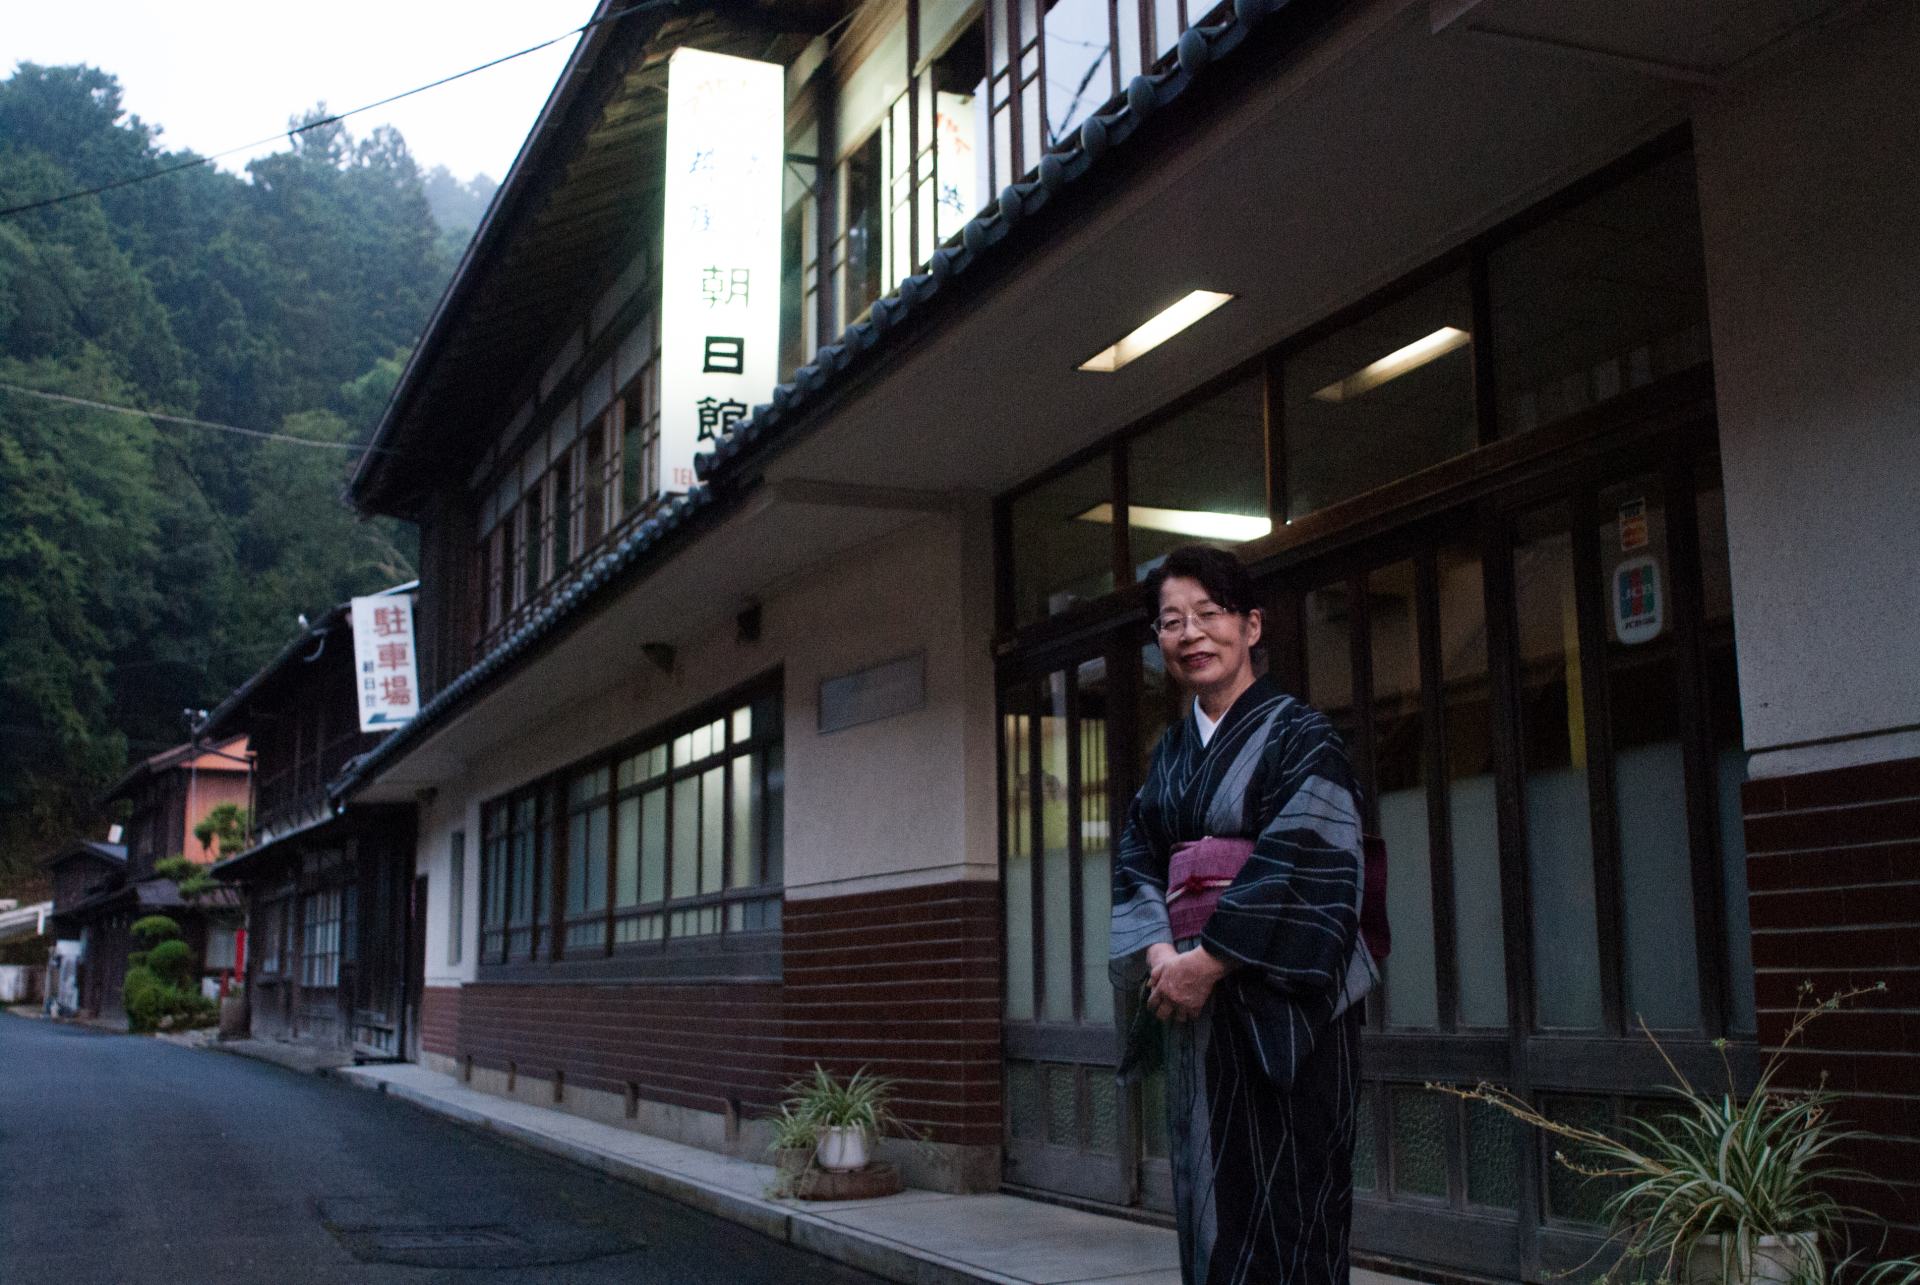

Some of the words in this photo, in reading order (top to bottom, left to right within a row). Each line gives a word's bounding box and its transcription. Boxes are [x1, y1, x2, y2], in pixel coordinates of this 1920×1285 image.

[696, 264, 750, 442] 朝日館
[374, 605, 411, 706] 駐車場
